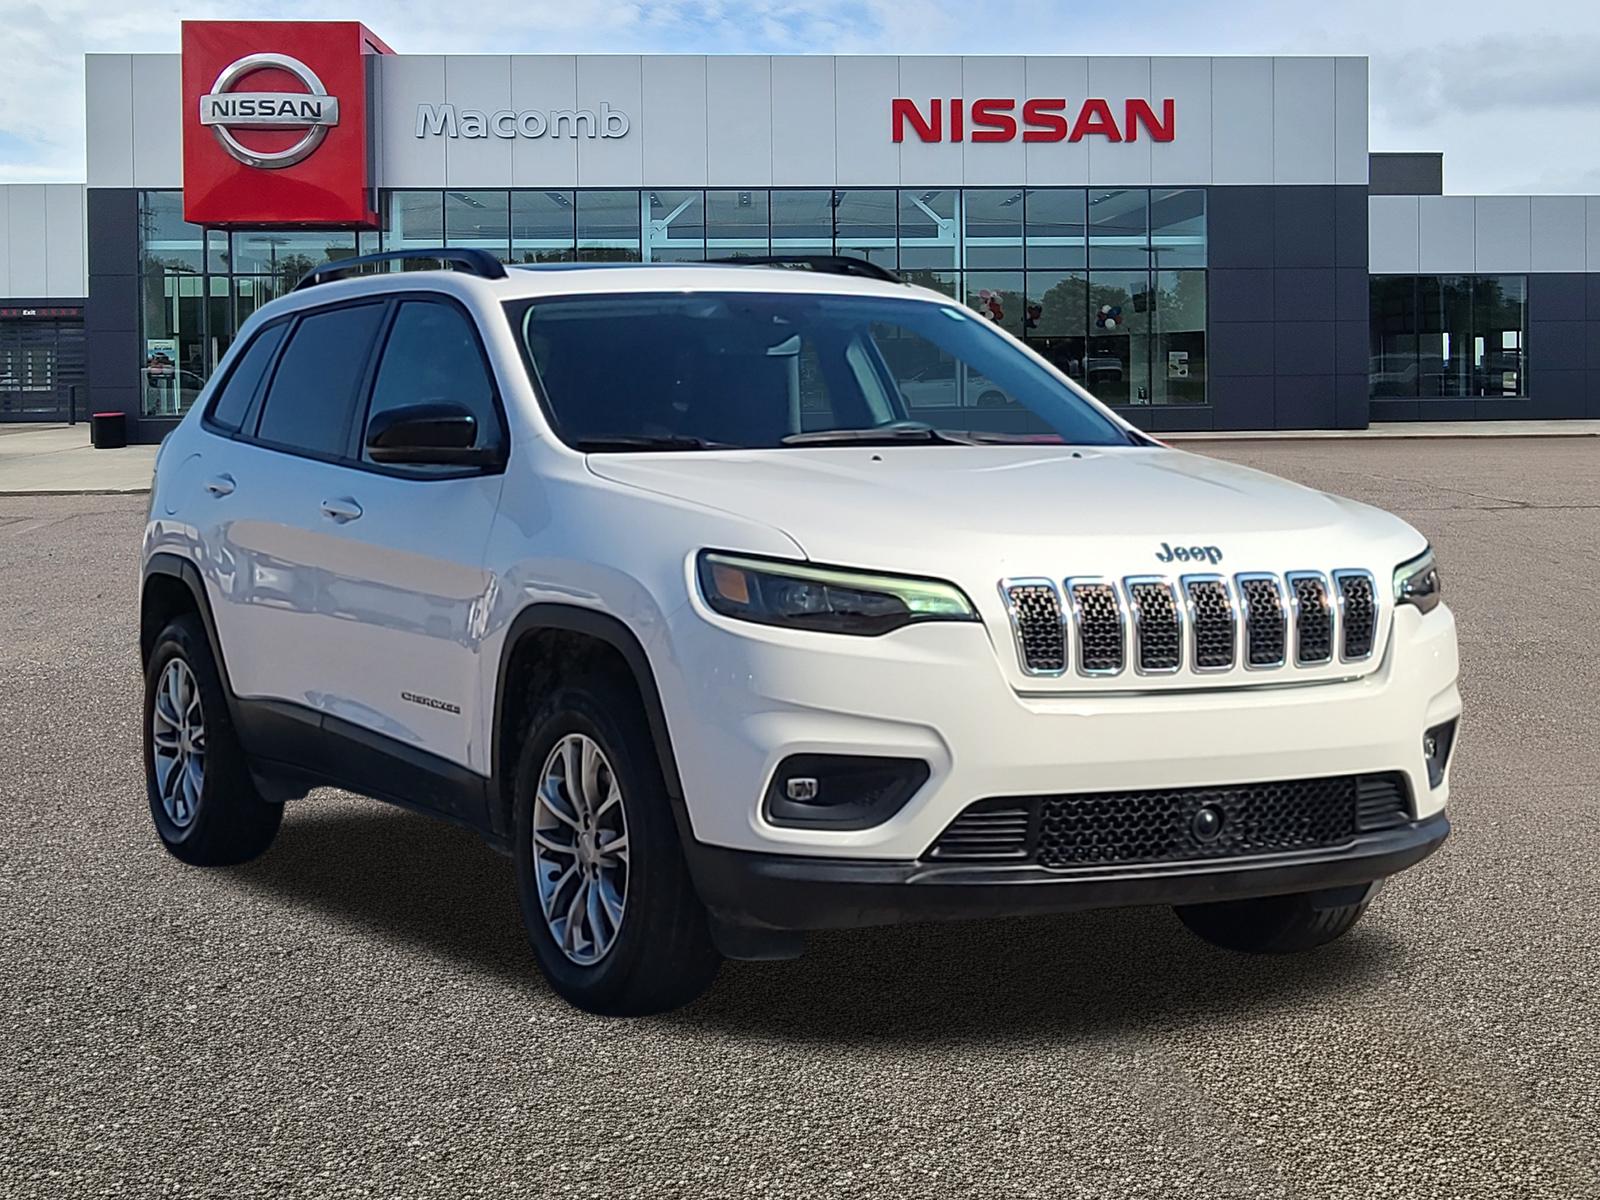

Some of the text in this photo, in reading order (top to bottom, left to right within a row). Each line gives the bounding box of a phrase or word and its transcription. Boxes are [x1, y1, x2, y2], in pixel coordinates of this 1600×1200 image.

[212, 100, 322, 118] NISSAN
[415, 101, 630, 139] Macomb
[893, 98, 1176, 143] NISSAN
[1155, 542, 1223, 565] Jeep
